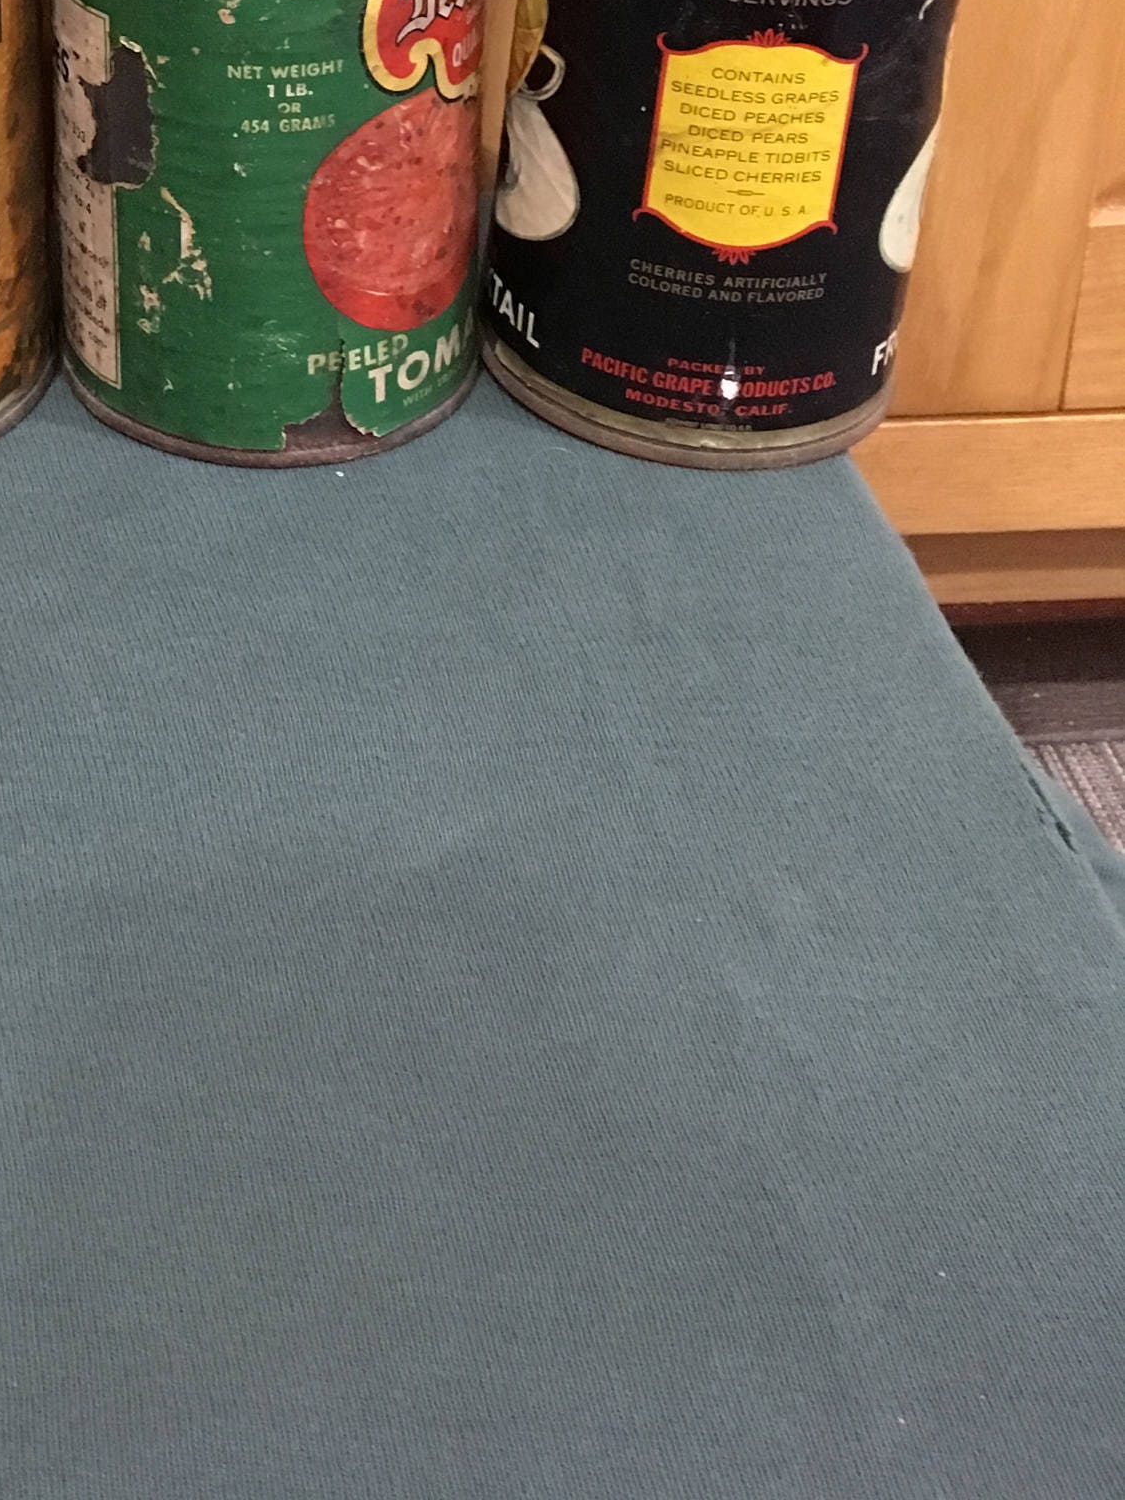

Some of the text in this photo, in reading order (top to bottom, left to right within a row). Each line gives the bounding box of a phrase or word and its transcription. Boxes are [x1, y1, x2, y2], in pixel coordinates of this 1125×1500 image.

[227, 58, 344, 80] NET WEIGHT
[711, 66, 806, 85] CONTAINS
[266, 83, 314, 98] 1 LB.
[670, 80, 841, 105] SEEDLESS GRAPES
[277, 102, 302, 114] OR
[679, 102, 827, 125] DICED PEACHES
[241, 113, 336, 134] 454 GRAMS
[687, 124, 810, 145] DICED PEARS
[660, 137, 832, 165] PINEAPPLE TIDBITS
[663, 159, 824, 184] SLICED CHERRIES
[664, 192, 736, 215] PRODUCT
[629, 258, 828, 290] CHERRIES ARTIFICIALLY
[627, 272, 826, 304] COLORED AND FLAVORED
[307, 333, 409, 376] PEELED
[580, 346, 649, 385] PACIFIC
[652, 370, 713, 398] GRAPE
[666, 357, 766, 376] PACKE BY
